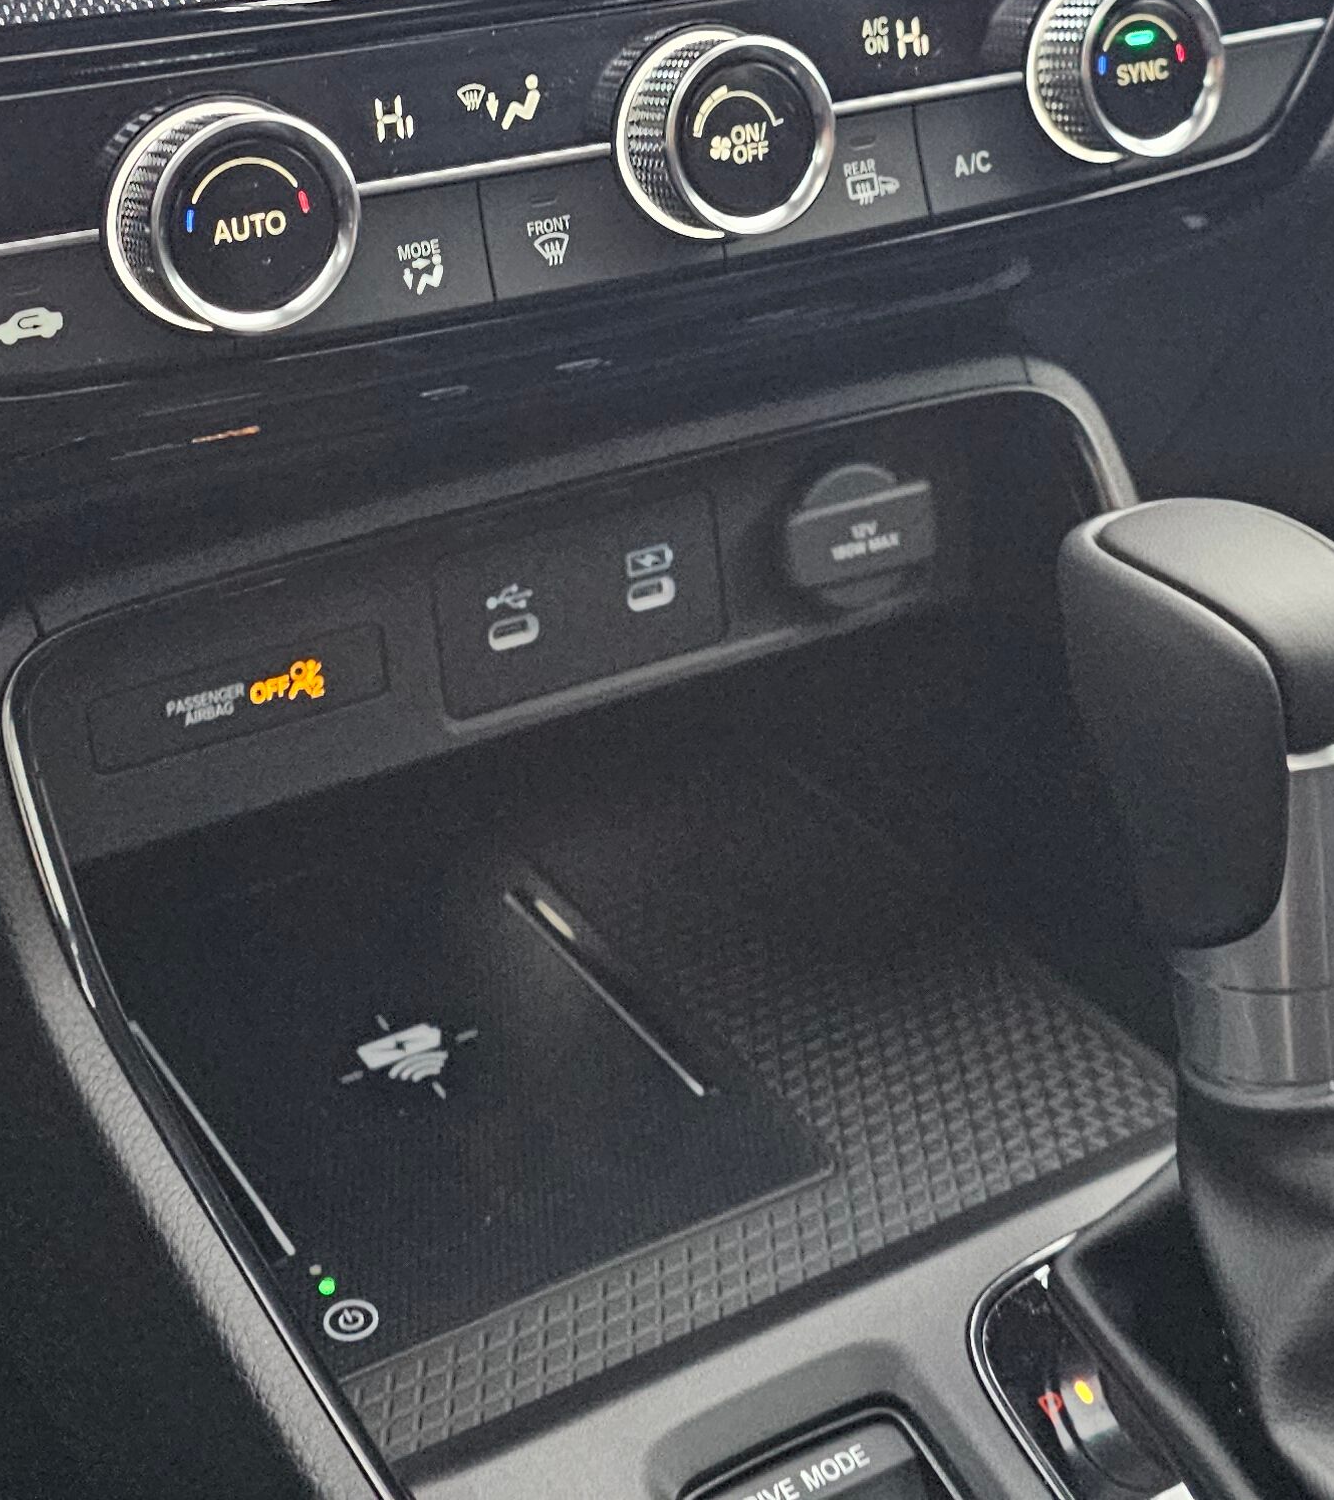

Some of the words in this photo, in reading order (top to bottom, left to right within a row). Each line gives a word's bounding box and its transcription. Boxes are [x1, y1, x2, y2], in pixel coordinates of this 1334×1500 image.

[862, 16, 889, 38] A/C
[865, 36, 890, 56] ON
[1116, 57, 1170, 87] SYNC
[731, 121, 767, 143] ON/
[732, 141, 769, 165] OFF
[955, 150, 993, 178] A/C
[843, 158, 876, 177] REAR
[214, 210, 287, 246] AUTO
[526, 214, 571, 237] FRONT
[397, 238, 441, 262] MODE
[166, 682, 245, 718] PASSENGER
[250, 674, 291, 705] OFF
[185, 702, 235, 728] AIRBAG
[799, 1443, 870, 1492] MODE
